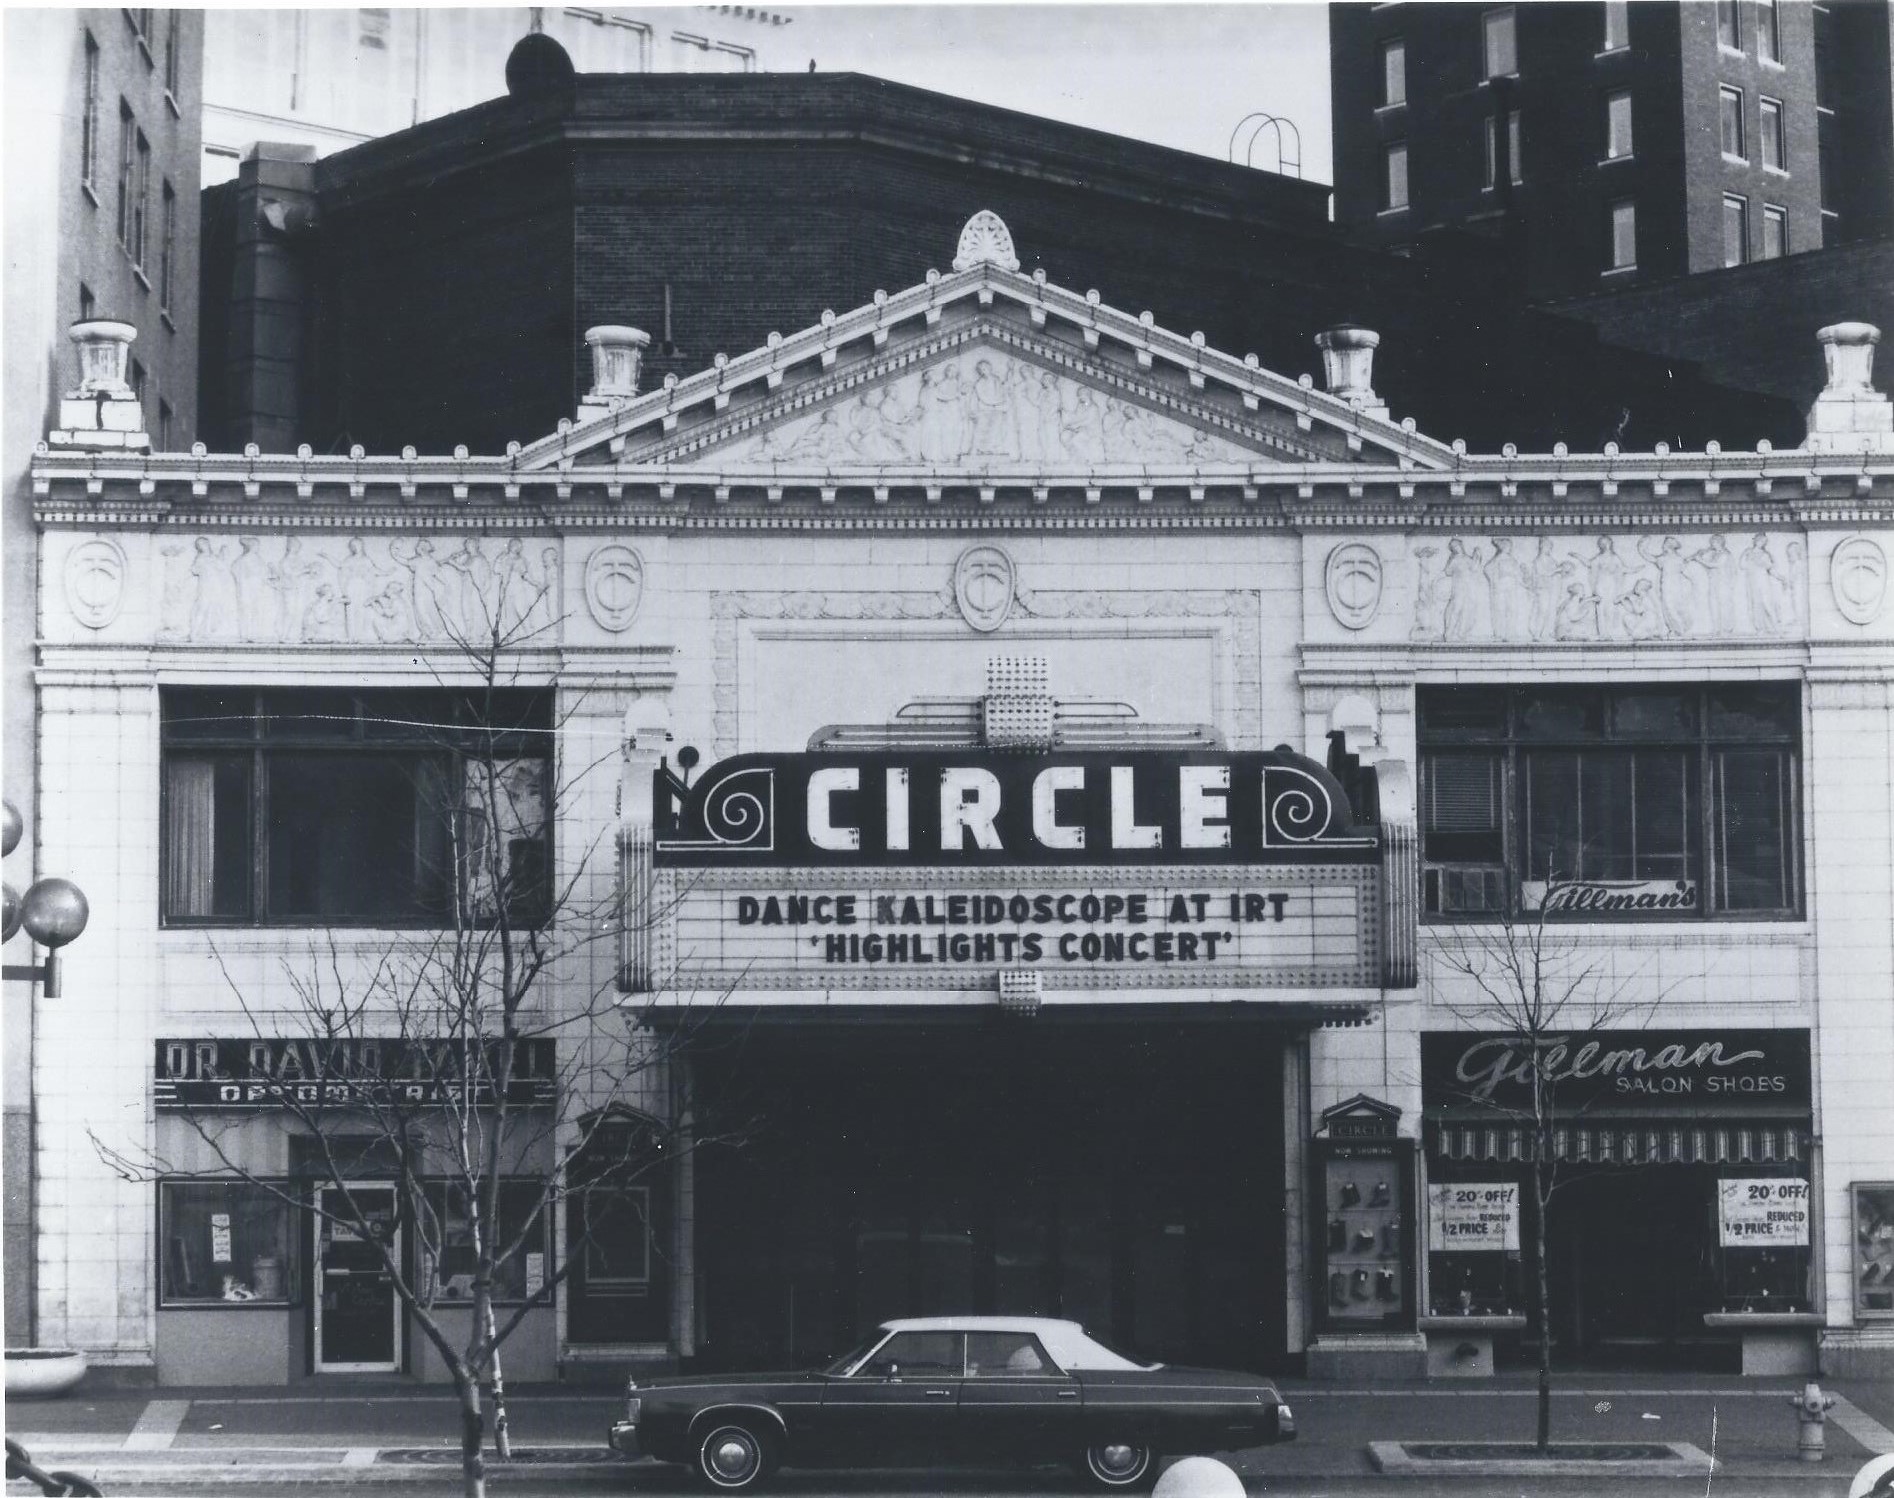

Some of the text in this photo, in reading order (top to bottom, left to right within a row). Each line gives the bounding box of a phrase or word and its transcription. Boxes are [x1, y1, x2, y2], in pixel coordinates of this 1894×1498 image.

[808, 766, 1231, 850] CIRCLE
[1541, 880, 1695, 909] Gillman's
[738, 893, 1289, 925] DANCE KALEIDOSCOPE AT IRT
[248, 1041, 381, 1079] DAVID
[1456, 1036, 1765, 1102] Gillman
[220, 1084, 490, 1101] OPTOMRIST
[1616, 1076, 1786, 1093] SALON SHOES
[1485, 1188, 1514, 1202] OFF!
[1778, 1184, 1809, 1199] OFF!
[1767, 1211, 1805, 1222] REDUCED
[1459, 1222, 1489, 1235] PRICE
[1744, 1222, 1774, 1235] PRICE
